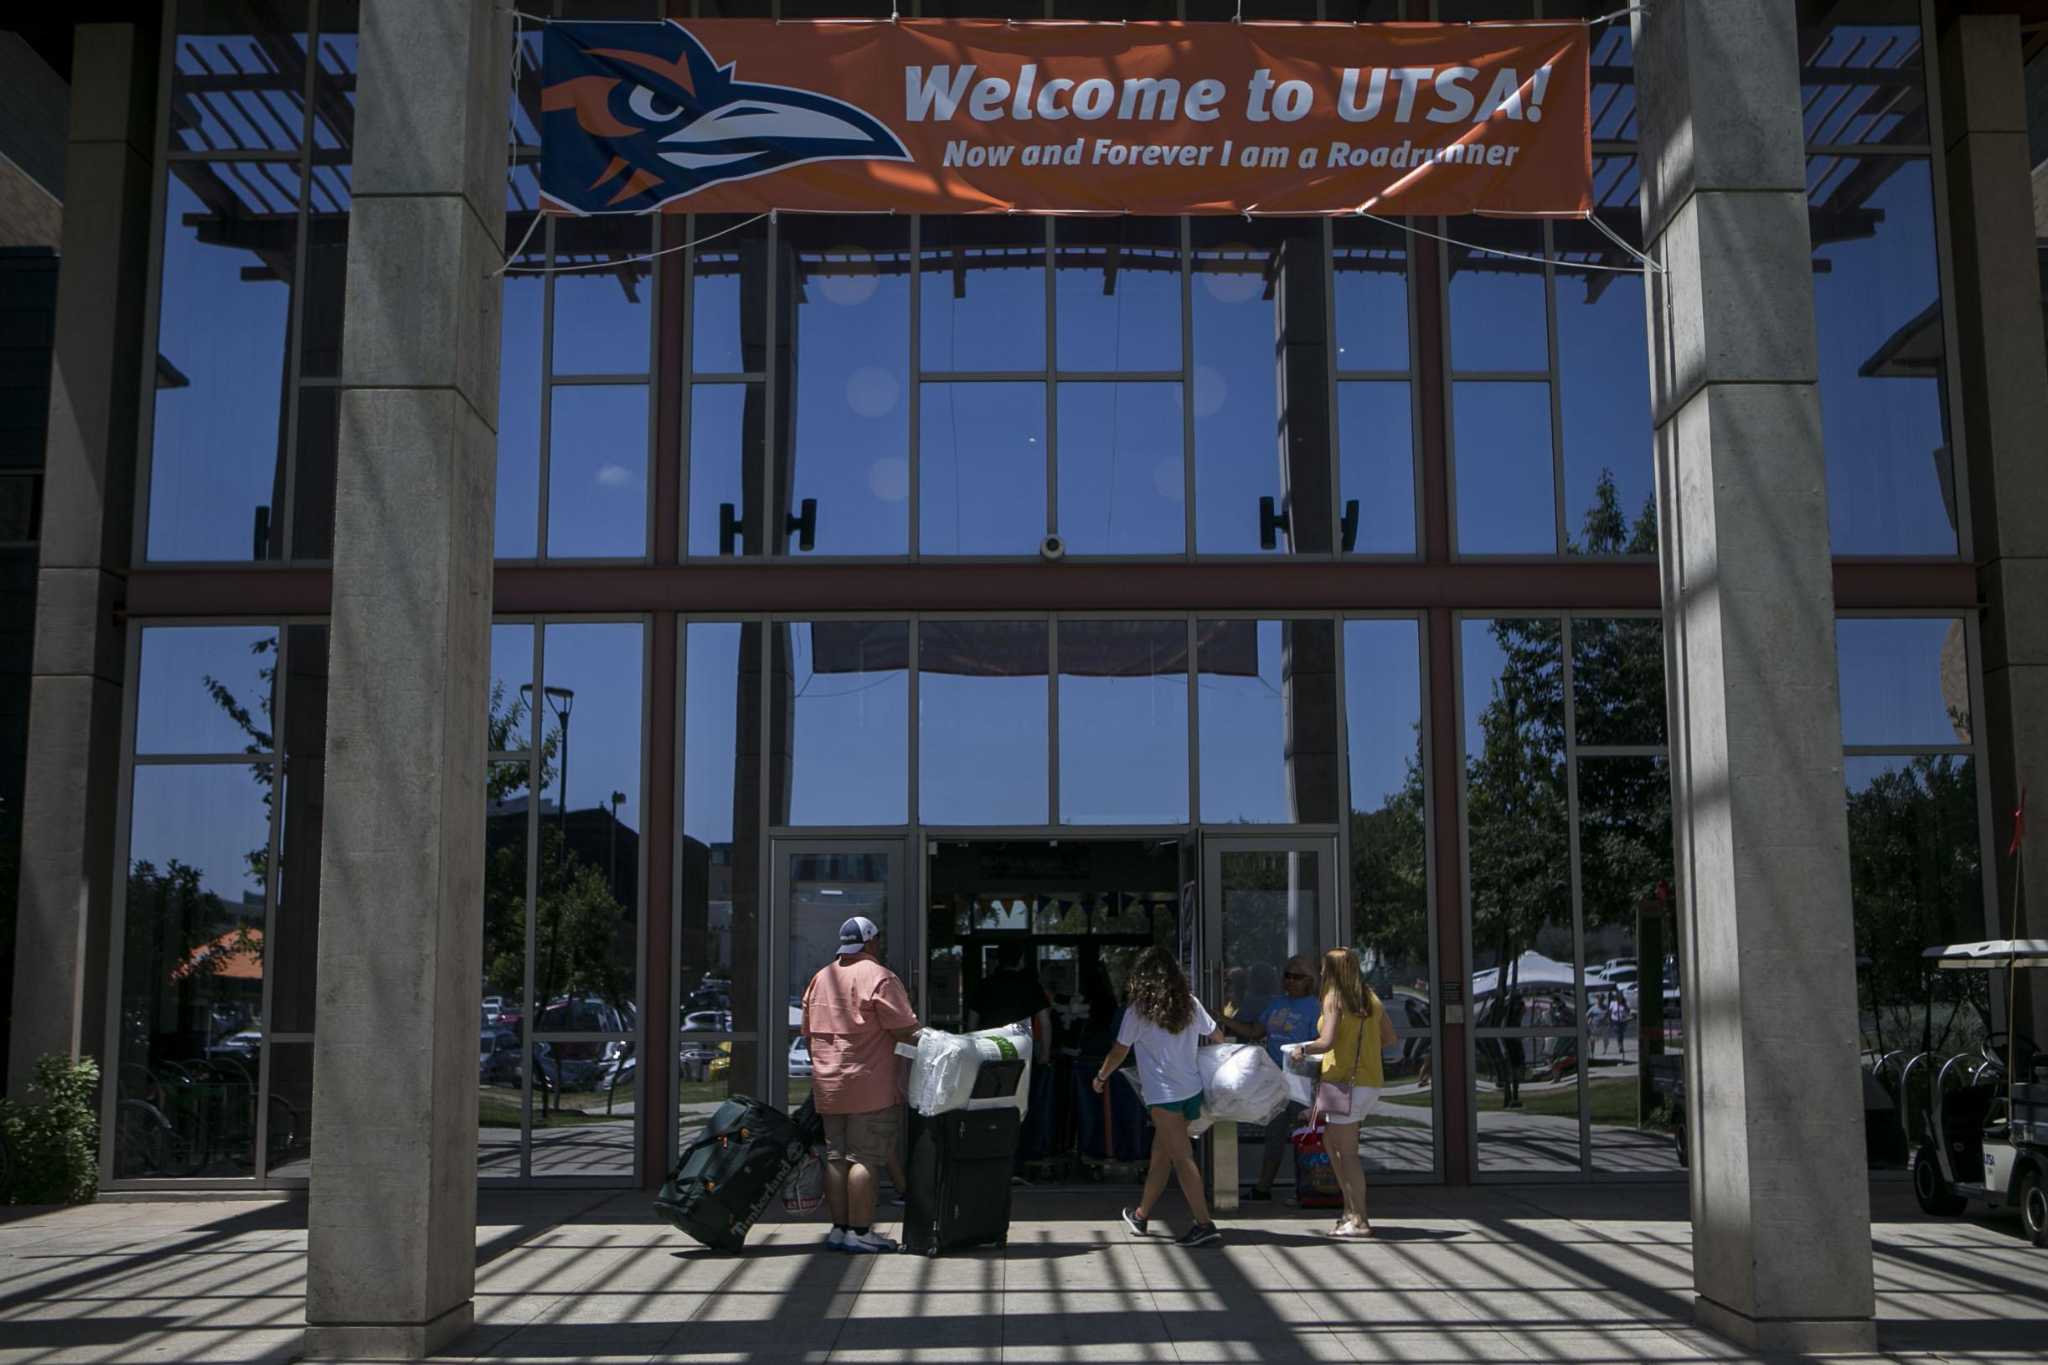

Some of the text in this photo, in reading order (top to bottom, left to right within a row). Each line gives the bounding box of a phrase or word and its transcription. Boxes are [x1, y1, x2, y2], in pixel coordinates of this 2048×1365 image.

[905, 63, 1553, 124] Welcome to UTSA!
[943, 137, 1520, 169] Now and Forever I am a Roadrunner
